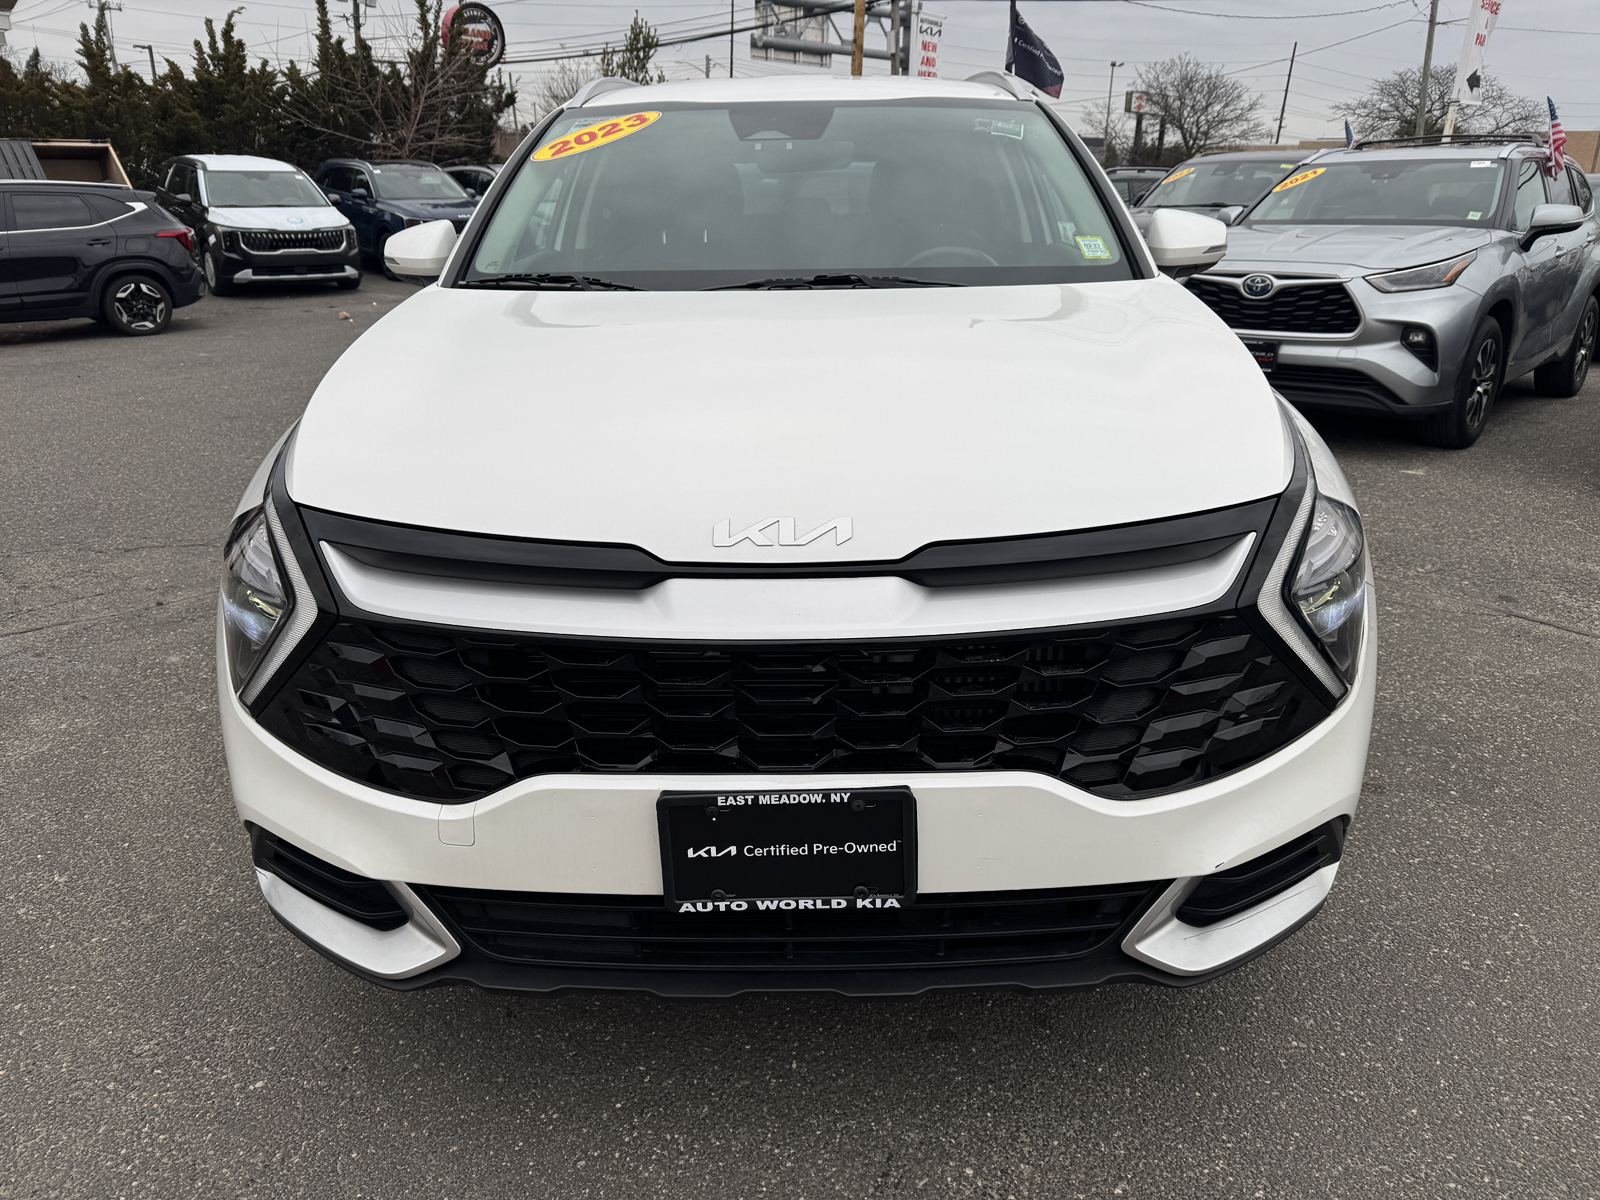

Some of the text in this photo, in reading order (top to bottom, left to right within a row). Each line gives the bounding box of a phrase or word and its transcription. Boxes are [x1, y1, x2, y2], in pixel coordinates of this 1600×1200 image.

[919, 25, 942, 37] KIA
[921, 40, 938, 53] NEW
[1018, 39, 1041, 57] Certified
[920, 55, 937, 68] AND
[548, 113, 651, 158] 2023
[1280, 169, 1318, 191] 2021
[712, 516, 853, 548] KIA
[717, 795, 754, 806] EAST
[830, 792, 851, 803] NY
[687, 845, 737, 858] KIA
[743, 843, 808, 857] Certified
[678, 898, 901, 913] AUTO WORLD KIA
